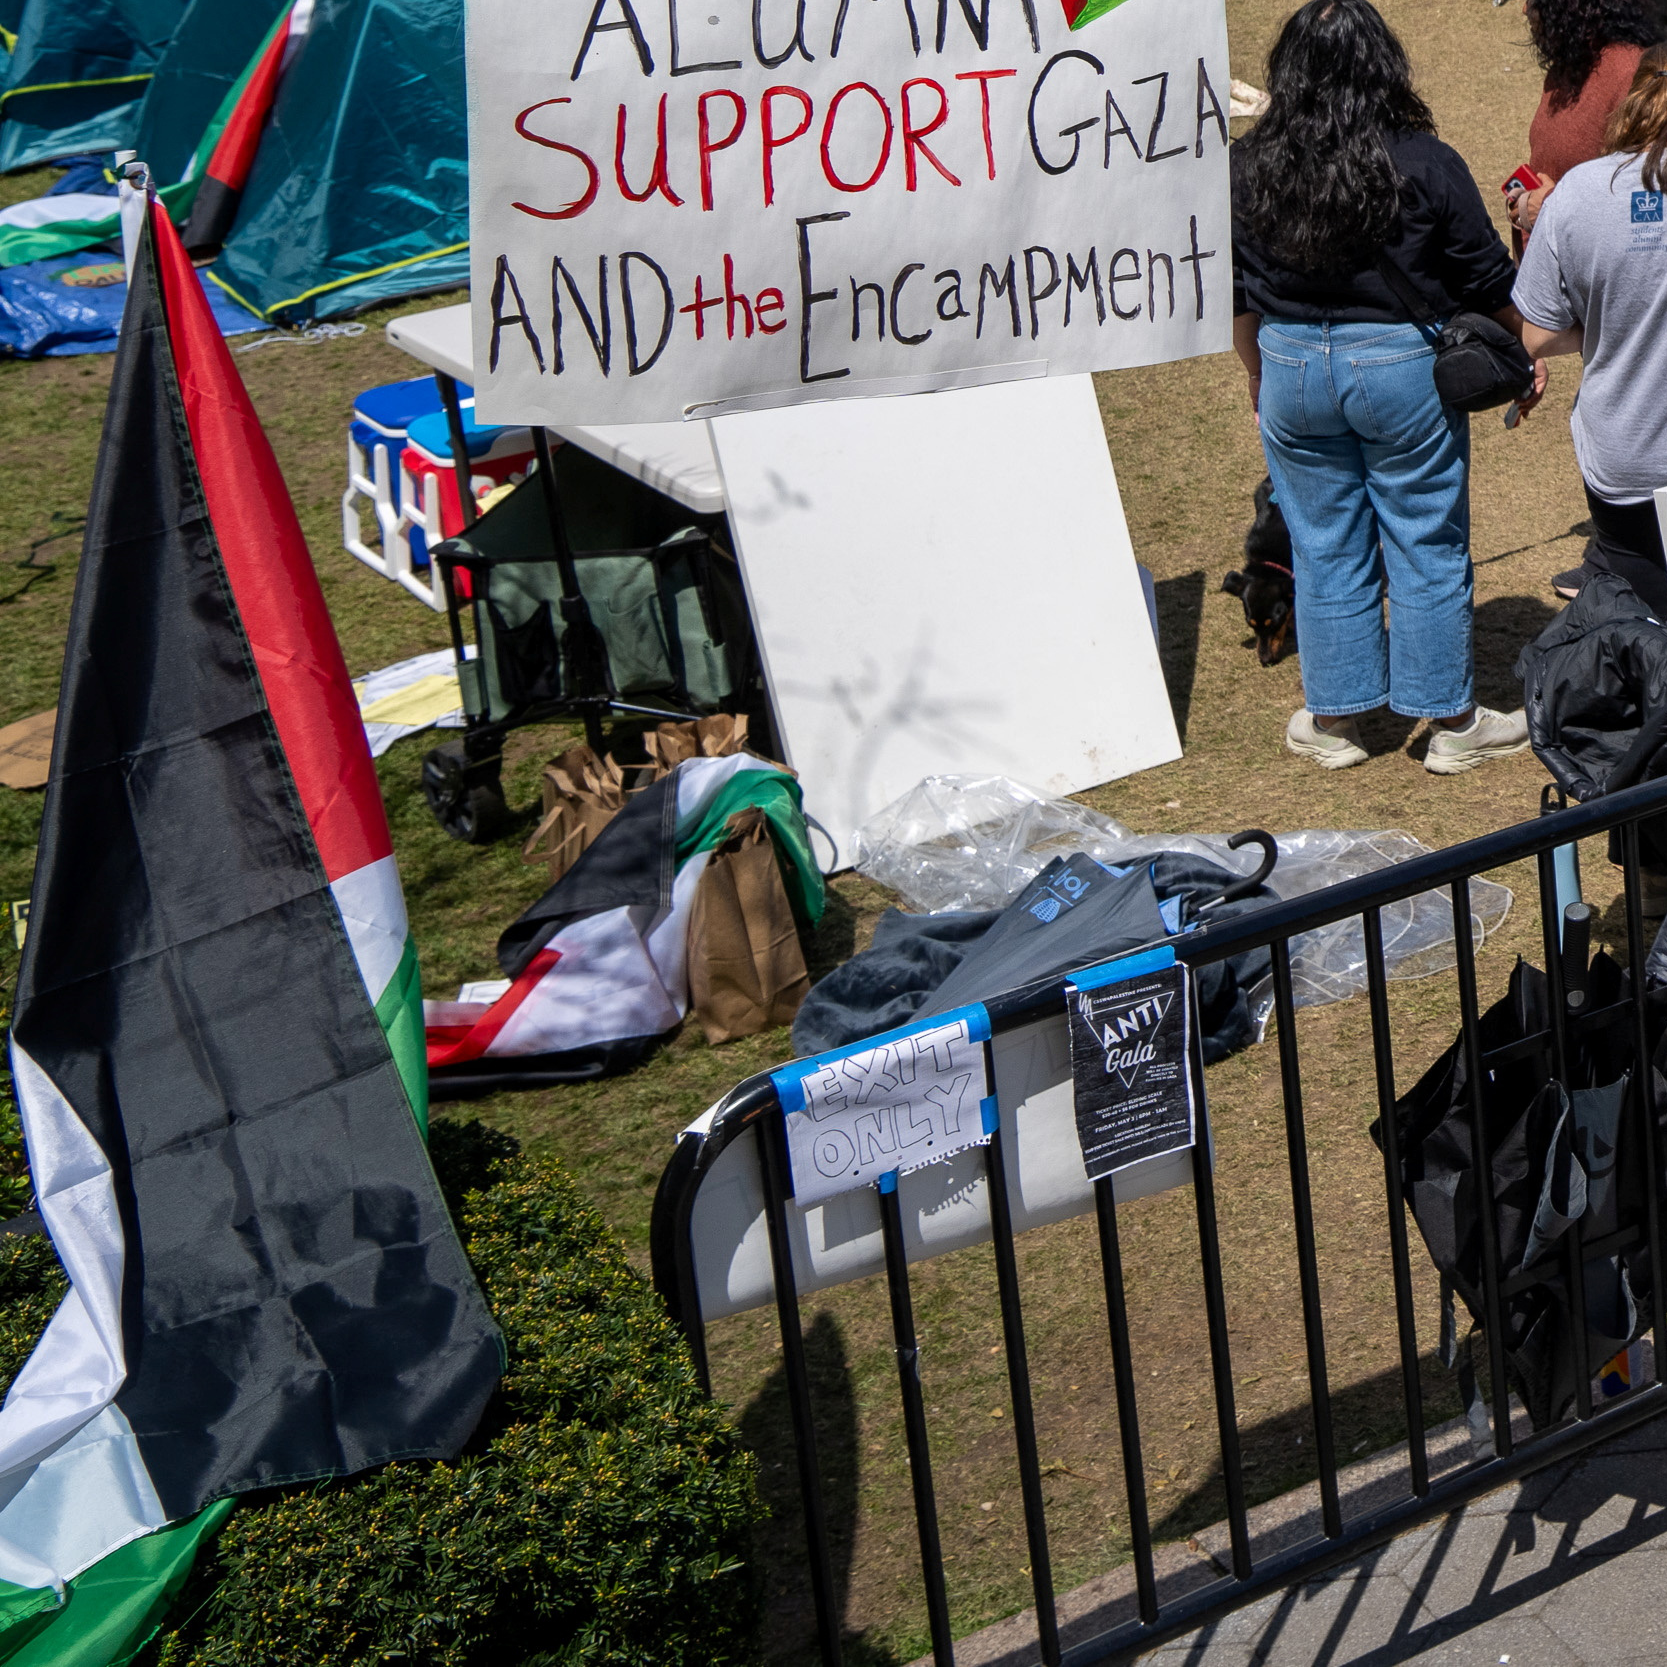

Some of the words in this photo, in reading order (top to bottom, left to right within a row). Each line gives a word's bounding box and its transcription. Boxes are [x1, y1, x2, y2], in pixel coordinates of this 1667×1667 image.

[509, 67, 1018, 222] SUPPORT
[1027, 48, 1228, 177] GAZA
[1633, 212, 1661, 223] CAA
[490, 249, 675, 378] AND
[680, 253, 788, 342] the
[802, 1022, 963, 1122] EXIT
[1104, 997, 1163, 1049] ANTI
[1106, 1040, 1156, 1073] Gala
[813, 1073, 971, 1177] ONLY
